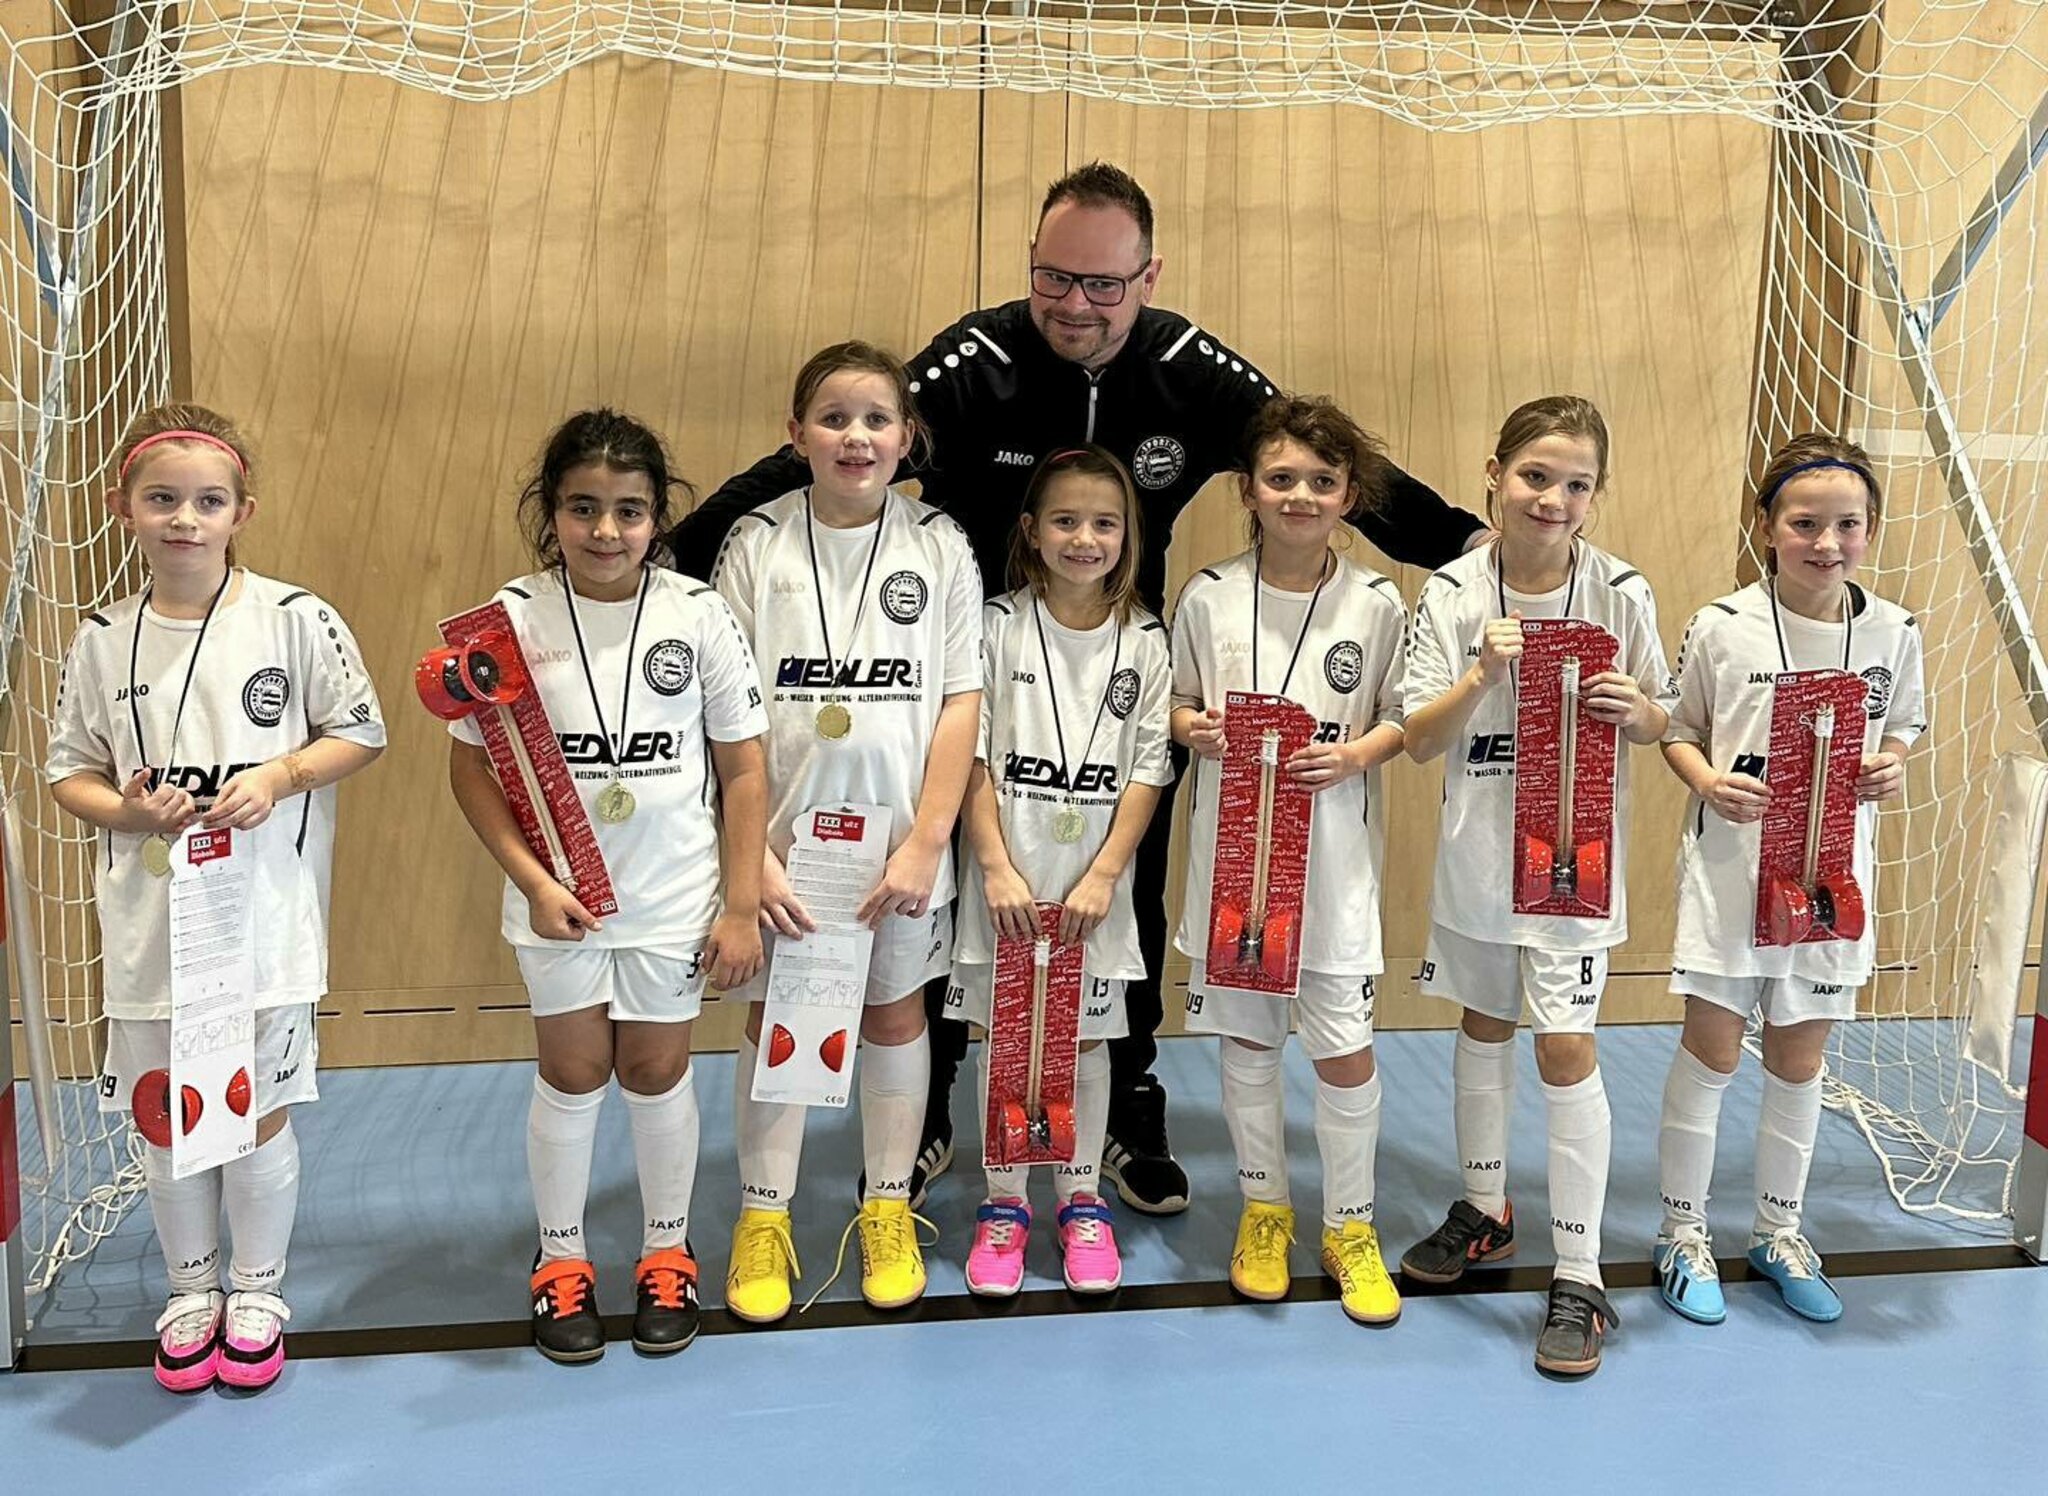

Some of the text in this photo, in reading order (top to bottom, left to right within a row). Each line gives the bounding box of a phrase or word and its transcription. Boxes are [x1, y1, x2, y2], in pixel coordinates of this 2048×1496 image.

[994, 450, 1035, 466] JAKO
[1748, 672, 1773, 684] JAK
[1581, 956, 1594, 985] 8
[1811, 983, 1842, 995] JAKO
[946, 985, 965, 1008] U9
[1186, 992, 1204, 1014] U9
[1570, 993, 1597, 1006] JAKO
[1058, 1164, 1092, 1176] JAKO
[1465, 1160, 1501, 1171] JAKO
[1238, 1168, 1266, 1180] AKO
[742, 1182, 778, 1199] JAKO
[1762, 1192, 1798, 1210] JAKO
[1336, 1202, 1373, 1215] JAKO
[649, 1217, 685, 1229] JAKO
[543, 1225, 578, 1239] JAKO
[180, 1248, 218, 1269] JAKO
